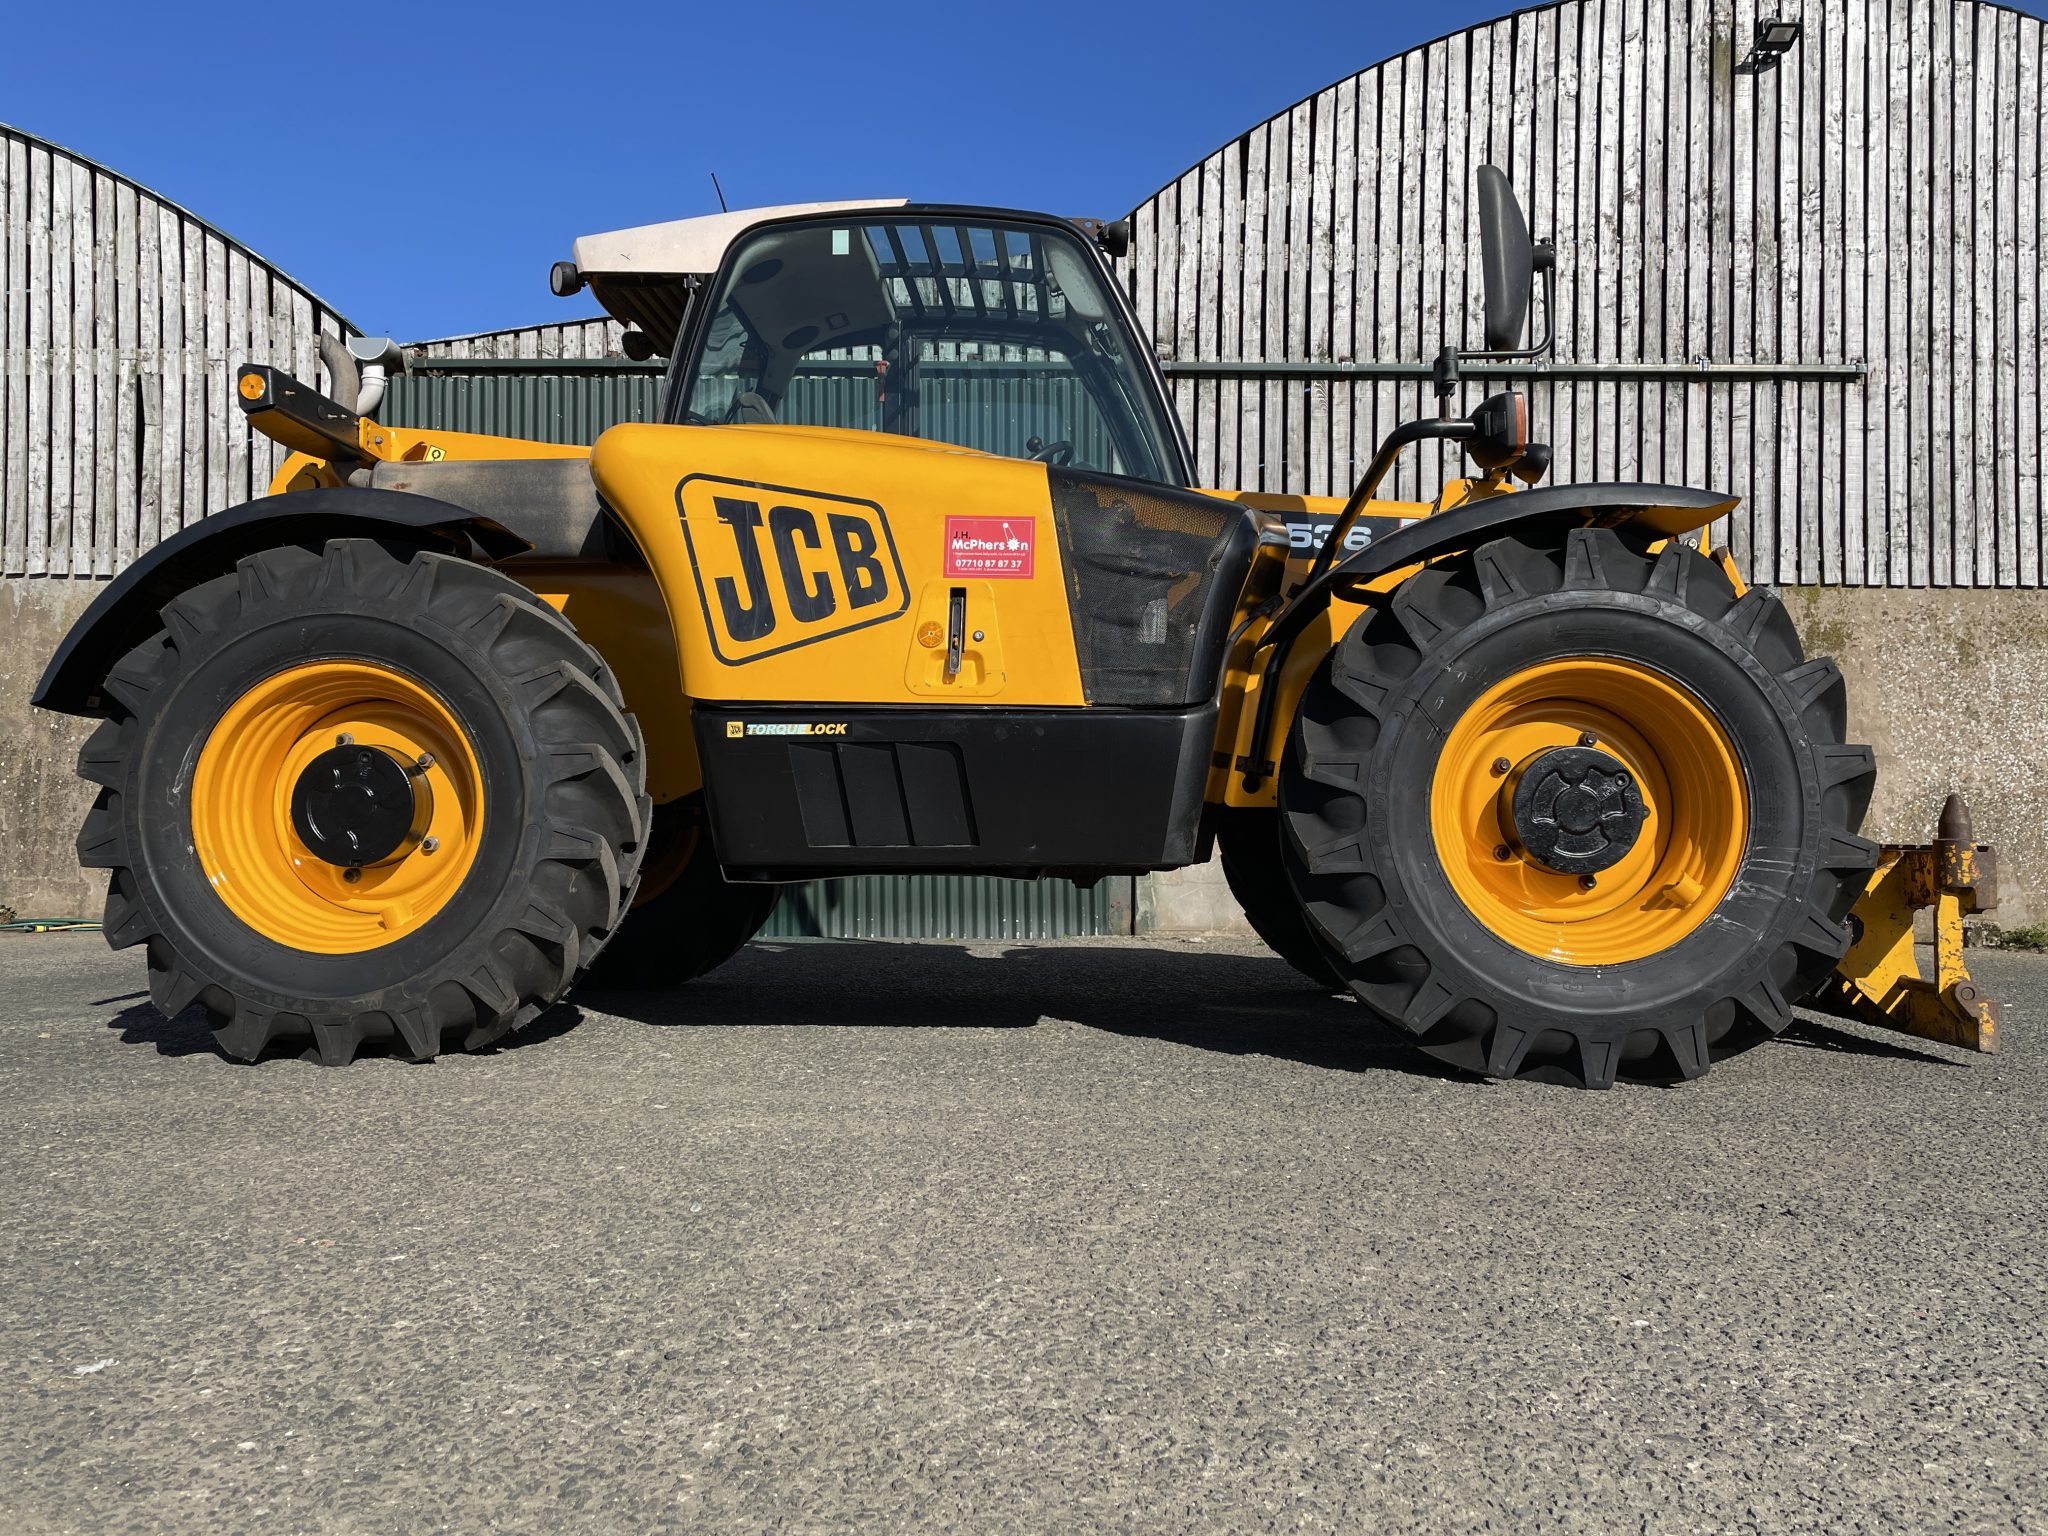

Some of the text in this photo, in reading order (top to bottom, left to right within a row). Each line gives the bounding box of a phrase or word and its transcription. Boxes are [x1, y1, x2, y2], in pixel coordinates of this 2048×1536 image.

[953, 531, 971, 539] J.H.
[1285, 522, 1372, 551] 536
[712, 496, 889, 642] JCB
[955, 559, 1022, 568] 07710 87 87 37
[746, 723, 848, 735] TORQUELOCK
